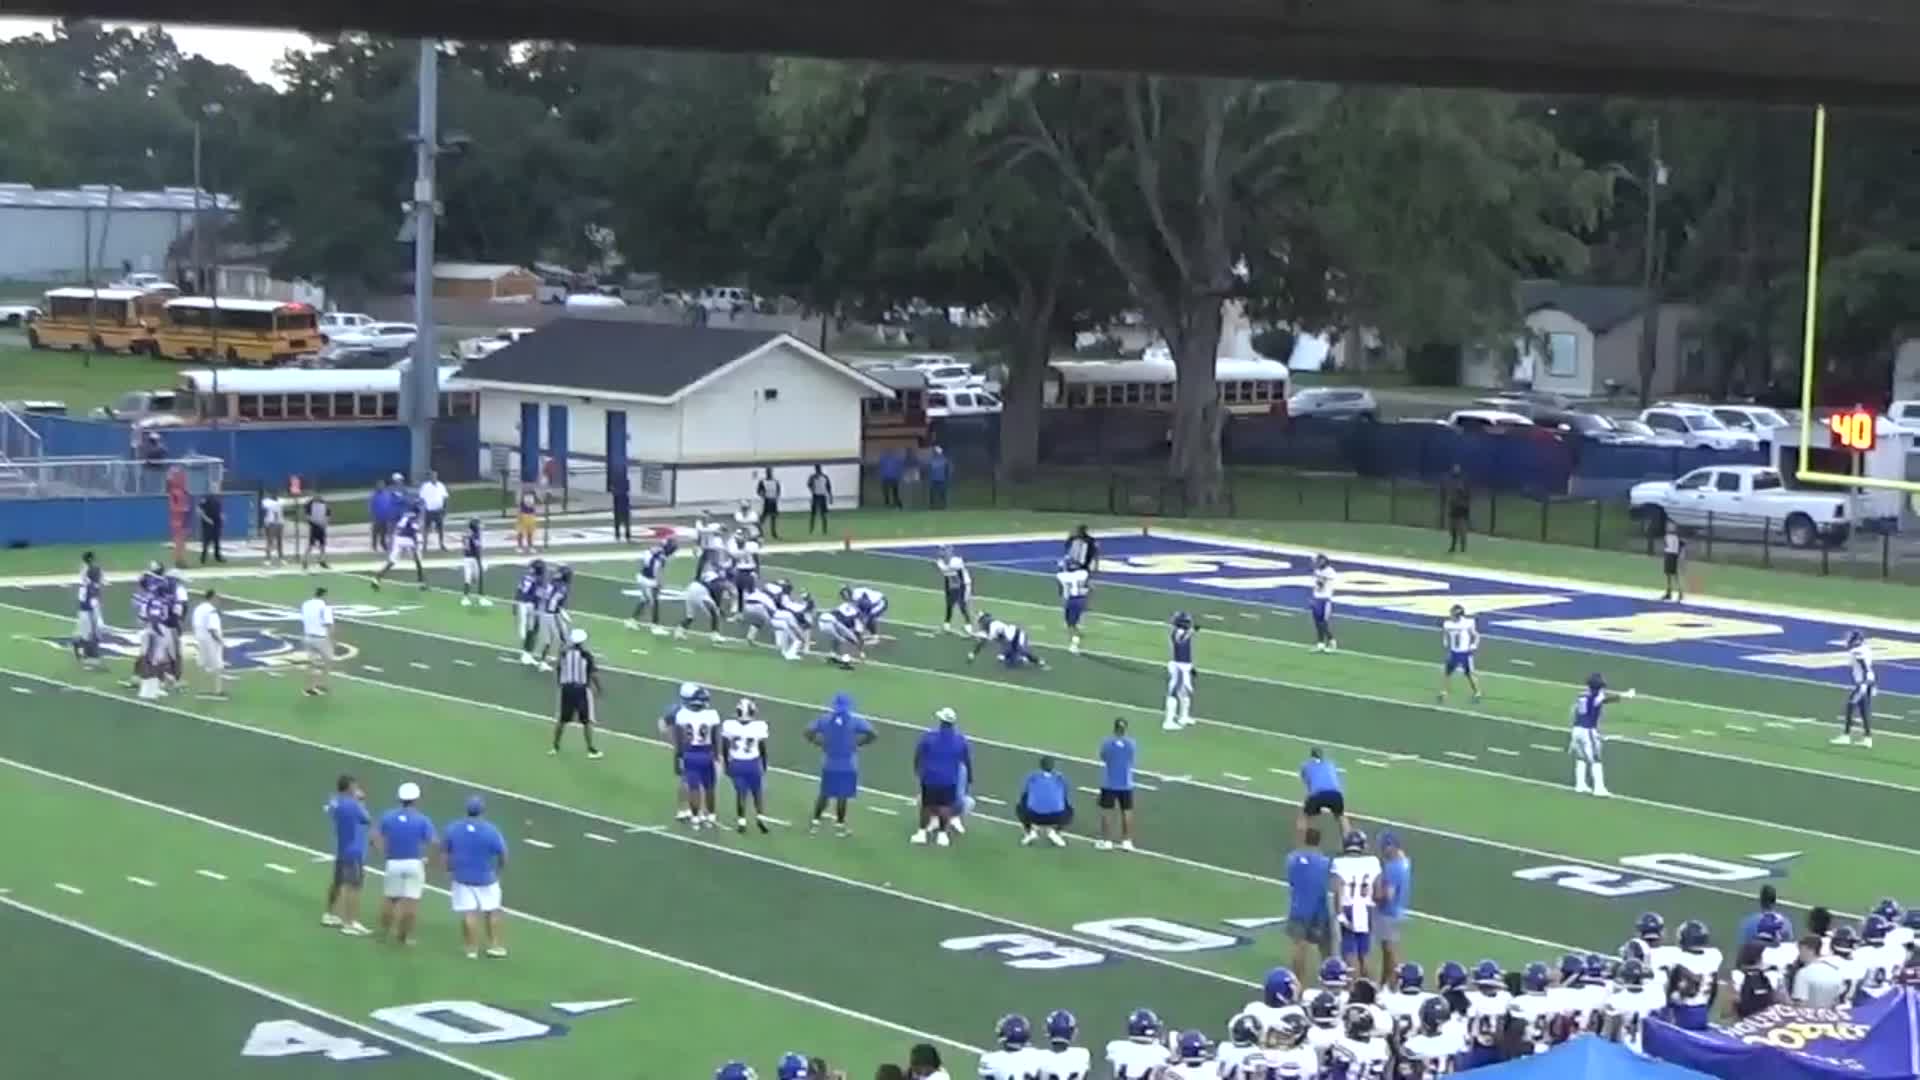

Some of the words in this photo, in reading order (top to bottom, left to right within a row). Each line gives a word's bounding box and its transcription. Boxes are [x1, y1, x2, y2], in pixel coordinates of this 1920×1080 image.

[1830, 412, 1873, 450] 40
[1512, 852, 1771, 897] 20
[939, 917, 1238, 970] 30
[240, 999, 551, 1061] 40
